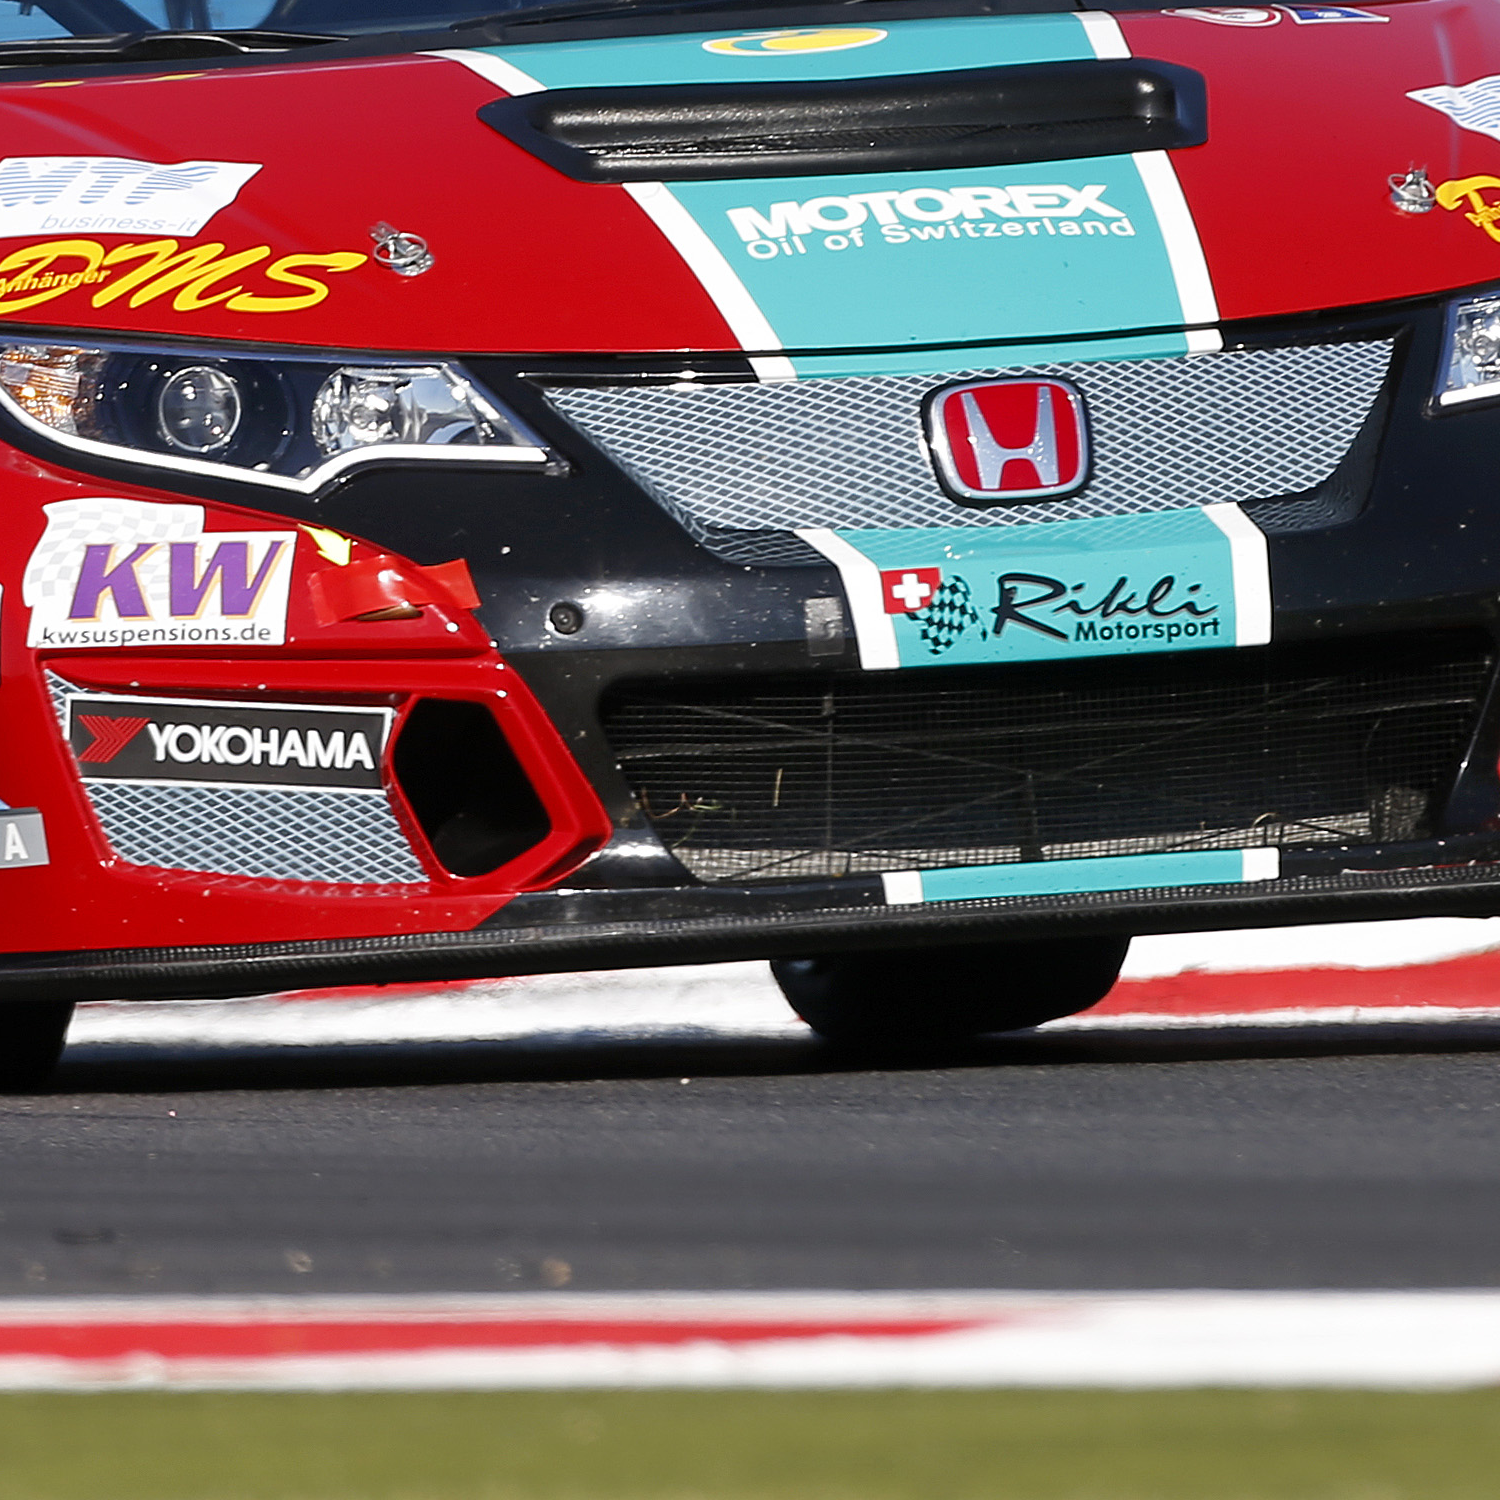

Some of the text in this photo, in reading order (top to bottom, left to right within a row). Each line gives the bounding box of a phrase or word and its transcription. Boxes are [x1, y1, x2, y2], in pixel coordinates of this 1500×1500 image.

[41, 213, 199, 232] business-it
[726, 184, 1127, 242] MOTOREX
[746, 217, 1135, 260] Oil of Switzerland
[67, 540, 291, 622] KW
[991, 572, 1218, 642] Rikli
[42, 623, 271, 645] kwsuspensions.de
[1074, 617, 1220, 643] Motorsport
[148, 723, 374, 770] YOKOHAMA
